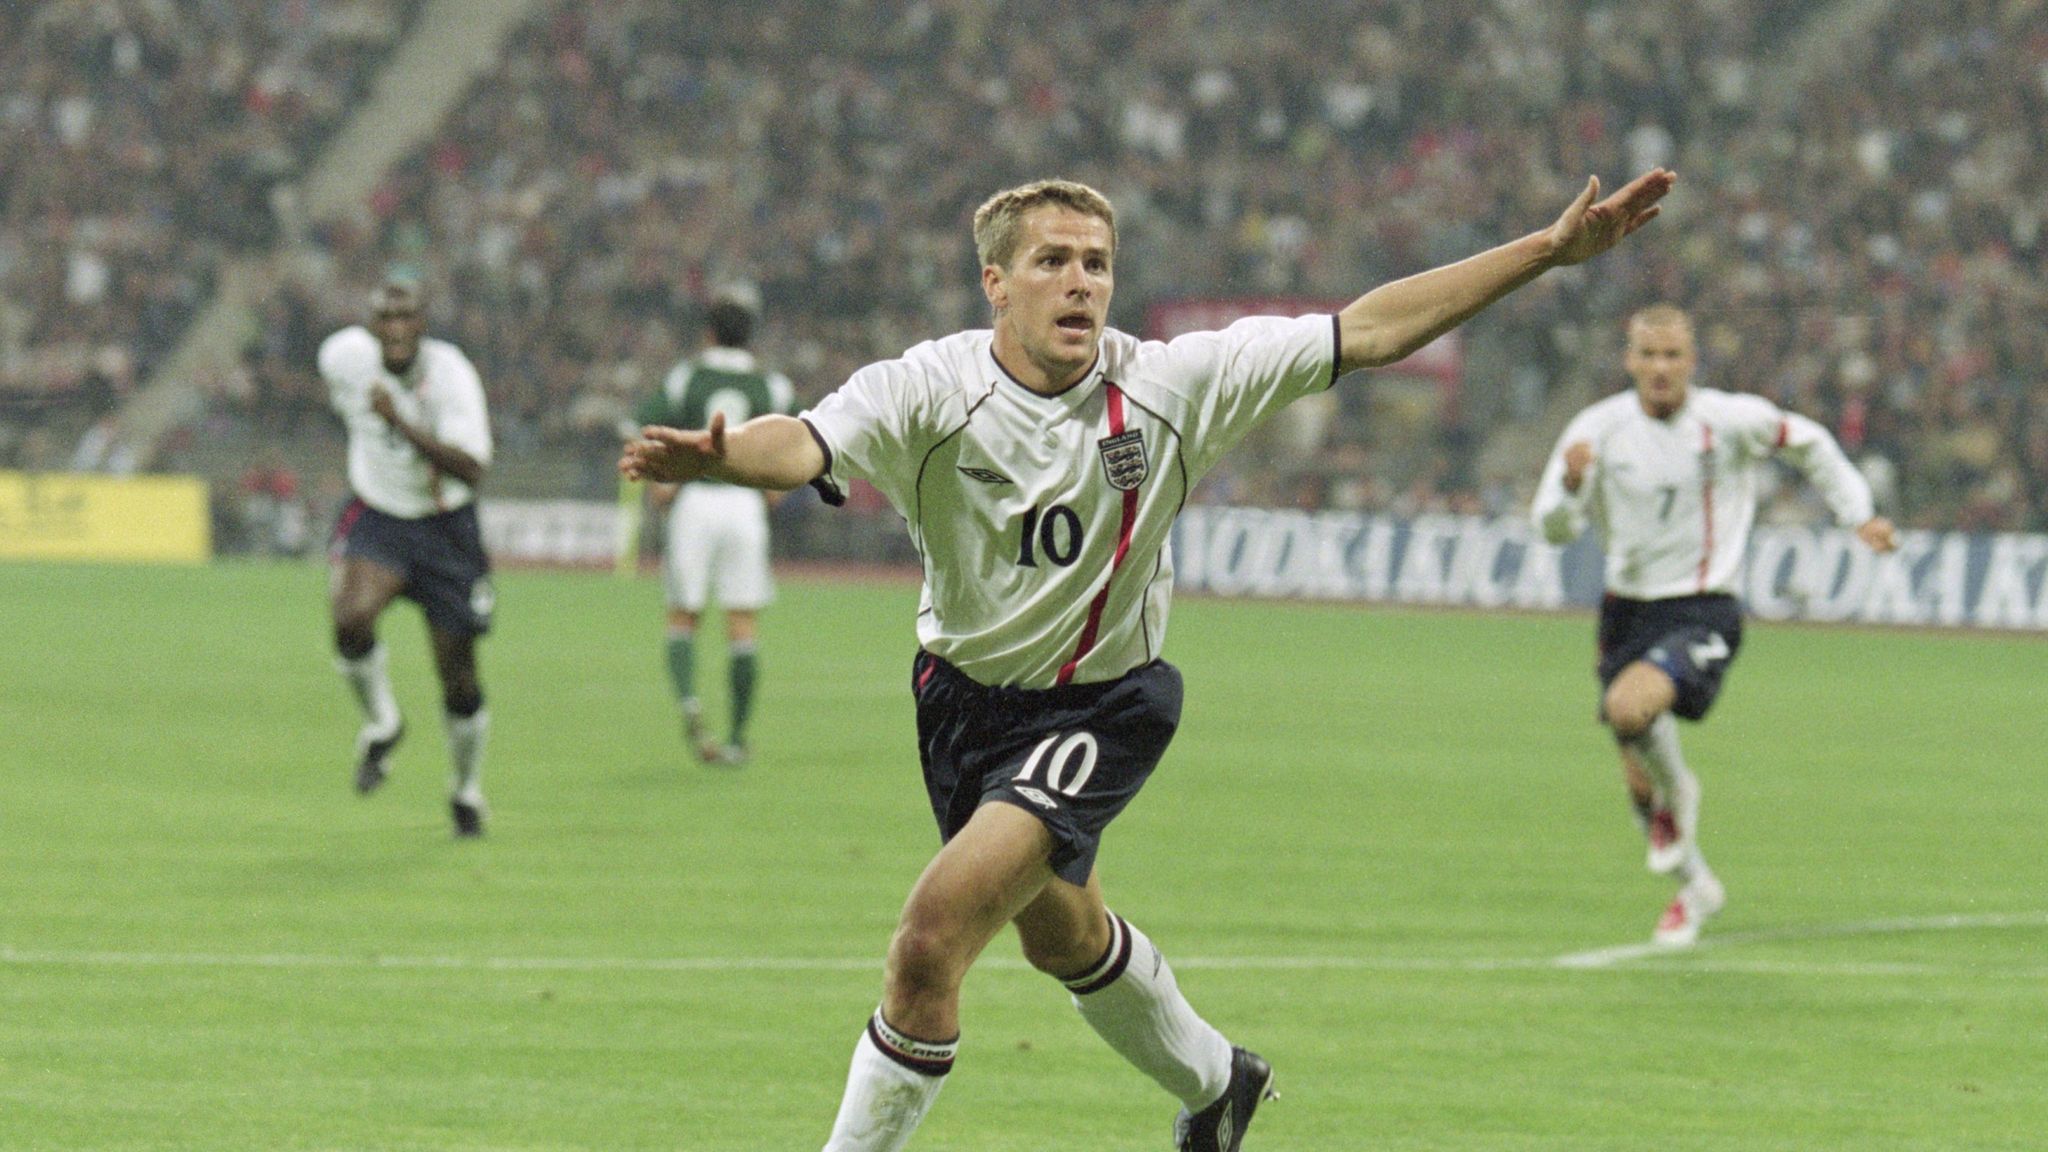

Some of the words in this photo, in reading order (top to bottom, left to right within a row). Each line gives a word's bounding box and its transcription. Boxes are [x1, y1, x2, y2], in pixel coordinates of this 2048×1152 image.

[1102, 432, 1139, 446] ENGLAND
[1656, 485, 1676, 522] 7
[1017, 504, 1083, 567] 10
[1011, 731, 1098, 796] 10
